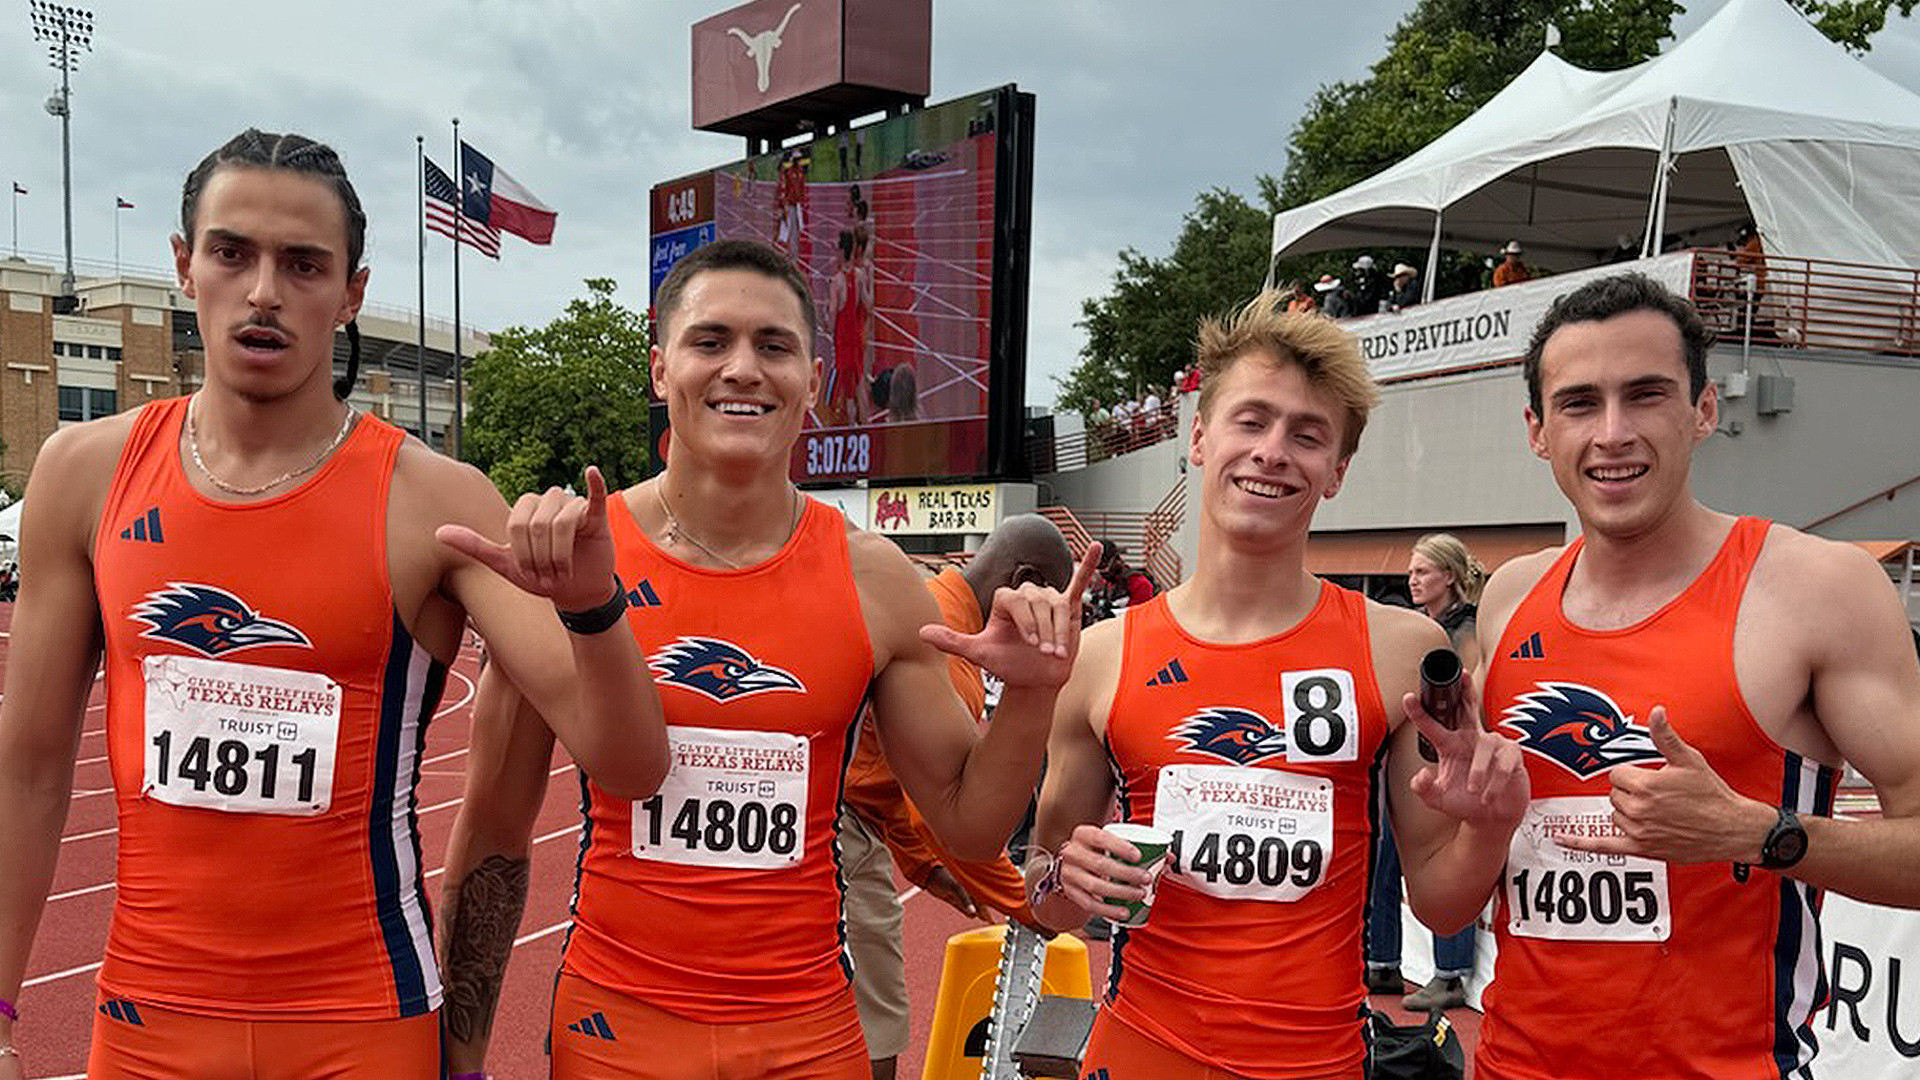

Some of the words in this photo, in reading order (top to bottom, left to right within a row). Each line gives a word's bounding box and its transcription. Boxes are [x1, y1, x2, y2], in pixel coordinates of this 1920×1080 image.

[668, 189, 695, 223] 4:49
[1404, 309, 1511, 353] PAVILION
[807, 434, 870, 475] 3:07.28
[919, 492, 948, 509] REAL
[951, 490, 991, 508] TEXAS
[929, 511, 977, 528] BAR-B-Q
[187, 687, 254, 707] TEXAS
[260, 696, 334, 717] RELAYS
[188, 677, 236, 691] CLYDE
[241, 683, 336, 703] LITTLEFIELD
[218, 718, 273, 735] TRUIST
[1294, 676, 1346, 756] 8
[678, 743, 719, 755] CLYDE
[153, 729, 317, 803] 14811
[678, 753, 738, 769] TEXAS
[743, 757, 804, 773] RELAYS
[708, 780, 756, 794] TRUIST
[1200, 789, 1259, 804] TEXAS
[1261, 793, 1328, 813] RELAYS
[642, 795, 797, 854] 14808
[1227, 815, 1276, 830] TRUIST
[1542, 824, 1585, 838] TEXAS
[1512, 869, 1659, 925] 14805
